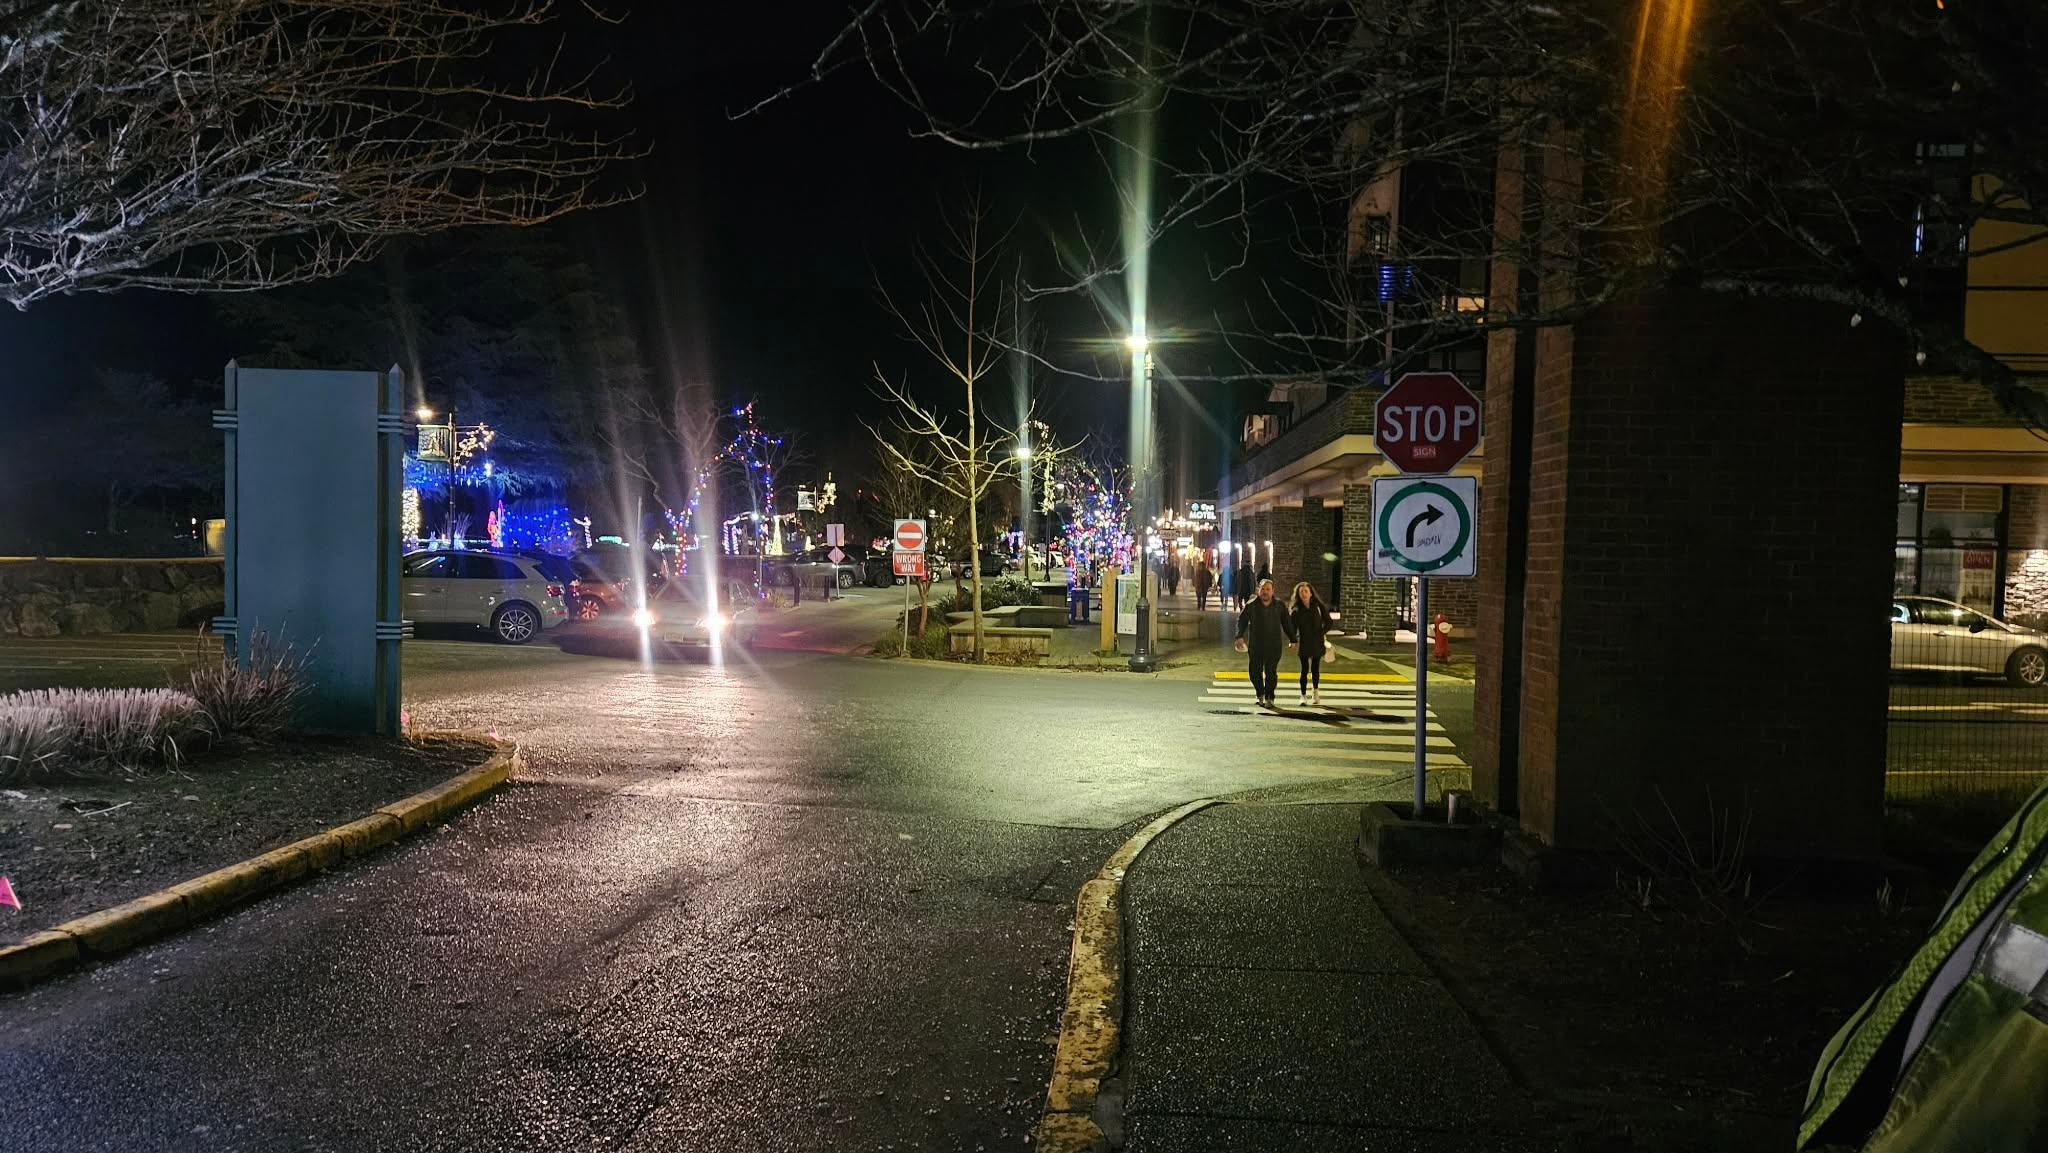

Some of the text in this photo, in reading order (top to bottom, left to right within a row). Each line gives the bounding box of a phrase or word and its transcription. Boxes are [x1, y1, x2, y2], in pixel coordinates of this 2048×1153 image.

[1382, 405, 1476, 442] STOP
[1413, 447, 1436, 457] SIGN
[1189, 510, 1216, 520] MOTEL
[895, 554, 921, 563] WRONG
[902, 563, 916, 573] WAY
